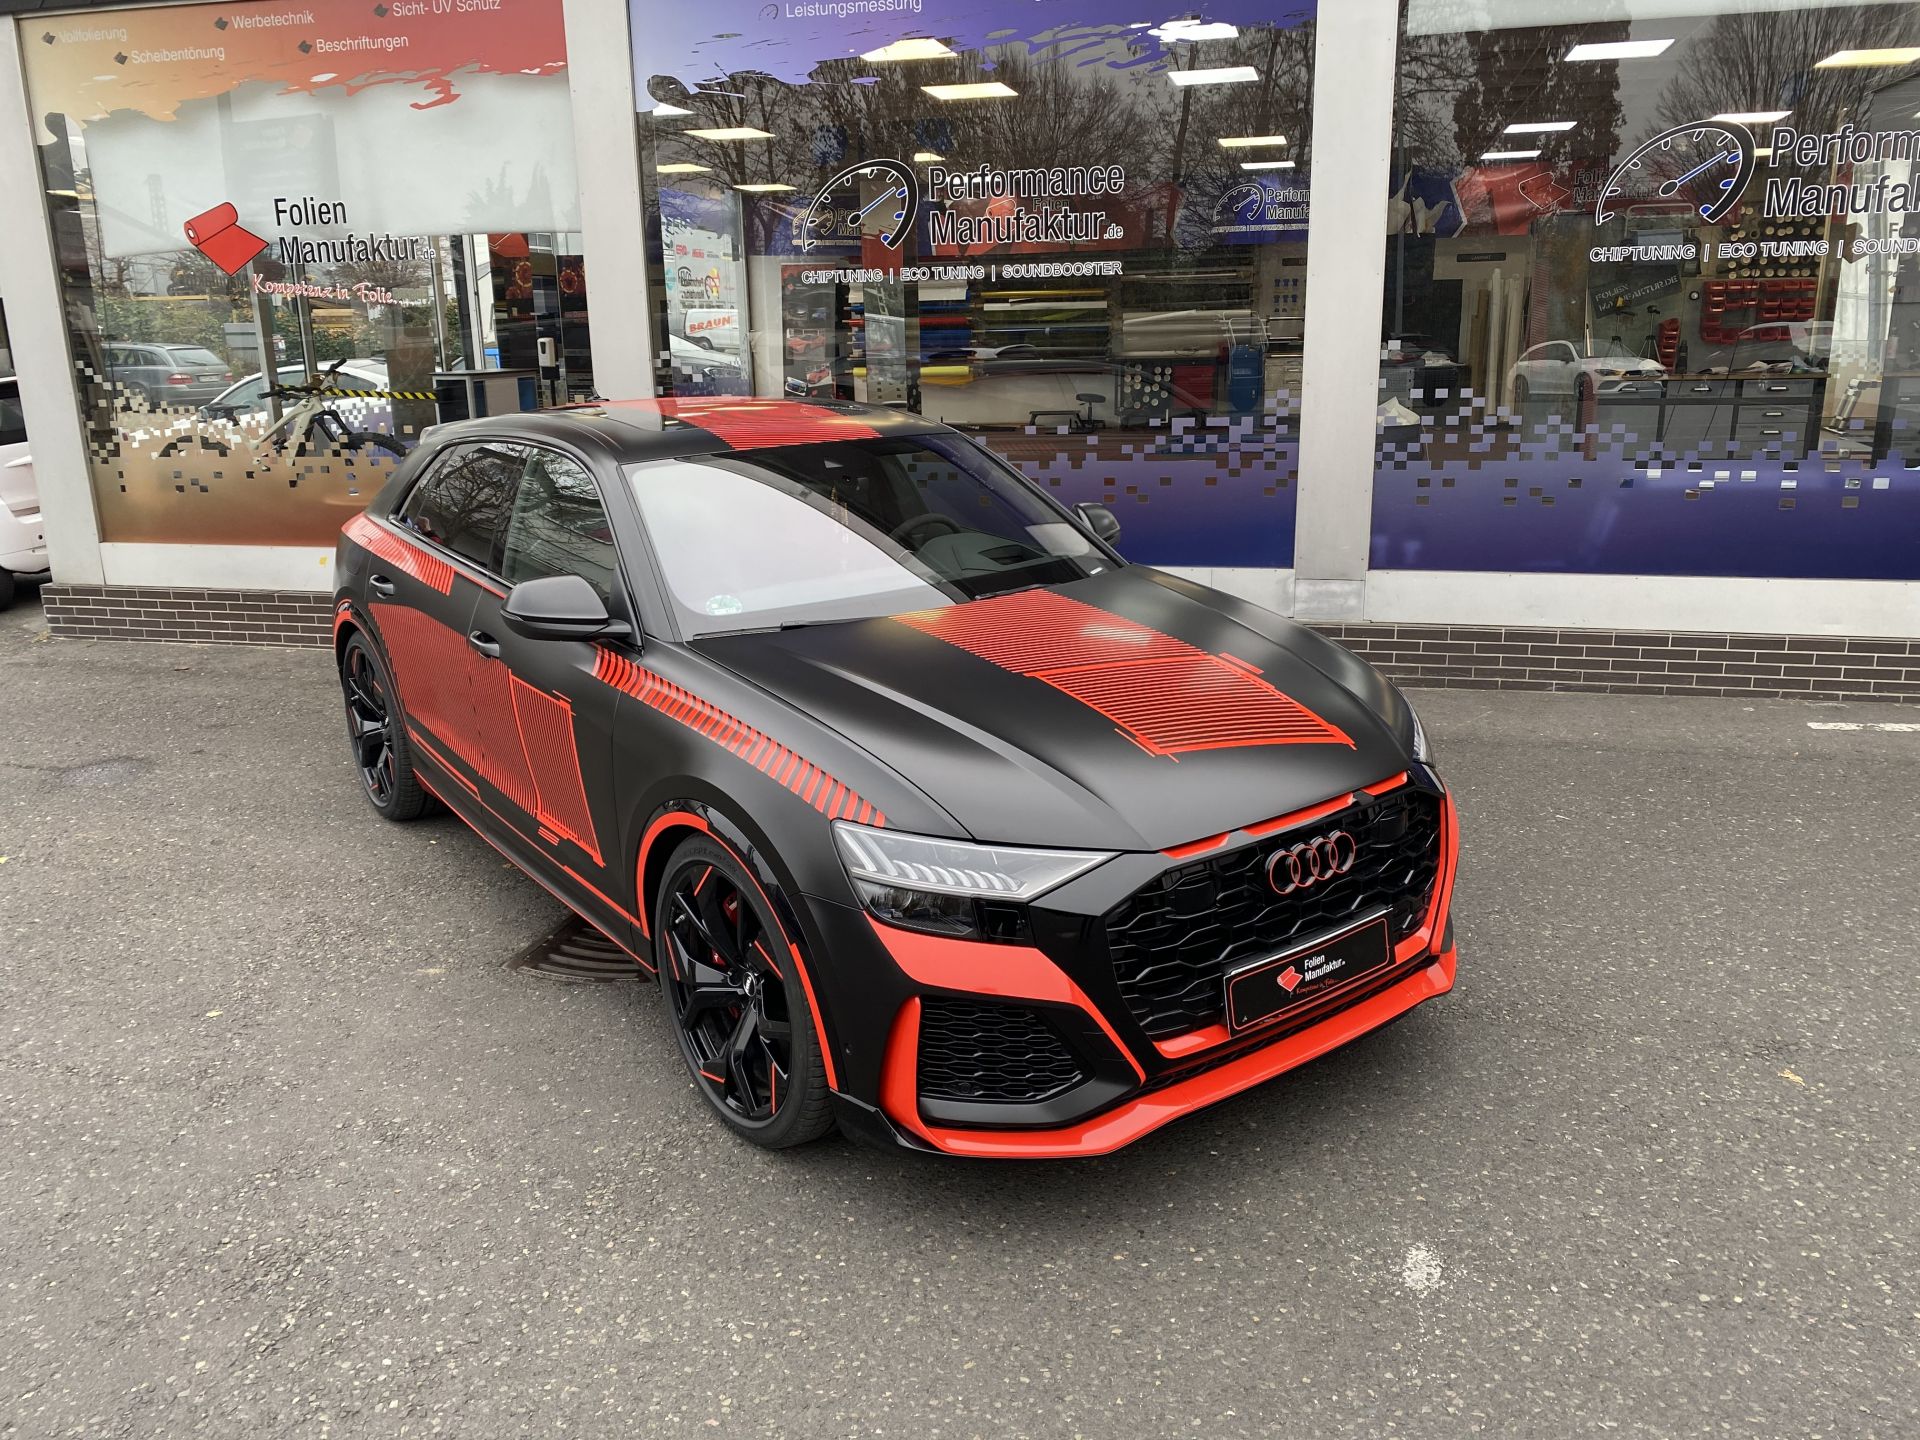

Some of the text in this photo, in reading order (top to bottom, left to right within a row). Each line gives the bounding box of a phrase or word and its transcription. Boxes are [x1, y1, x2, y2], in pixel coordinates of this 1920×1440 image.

[392, 0, 501, 18] Sicht- UV Schutz
[785, 0, 922, 18] Leistungsmessung
[231, 11, 315, 29] Werbetechnik
[59, 27, 127, 43] Vollfolierung
[316, 35, 409, 53] Beschriftungen
[131, 46, 225, 64] Scheibentönung
[928, 164, 1125, 201] Performance
[273, 196, 347, 226] Folien
[1589, 238, 1920, 263] CHIPTUNING ECO TUNING SOUND
[801, 261, 1123, 284] CHIPTUNING ECO TUNING SOUNDBOOSTER
[252, 273, 332, 300] Kompetenz
[336, 283, 350, 300] in
[690, 317, 731, 332] BRAUN
[1305, 955, 1325, 970] Folien
